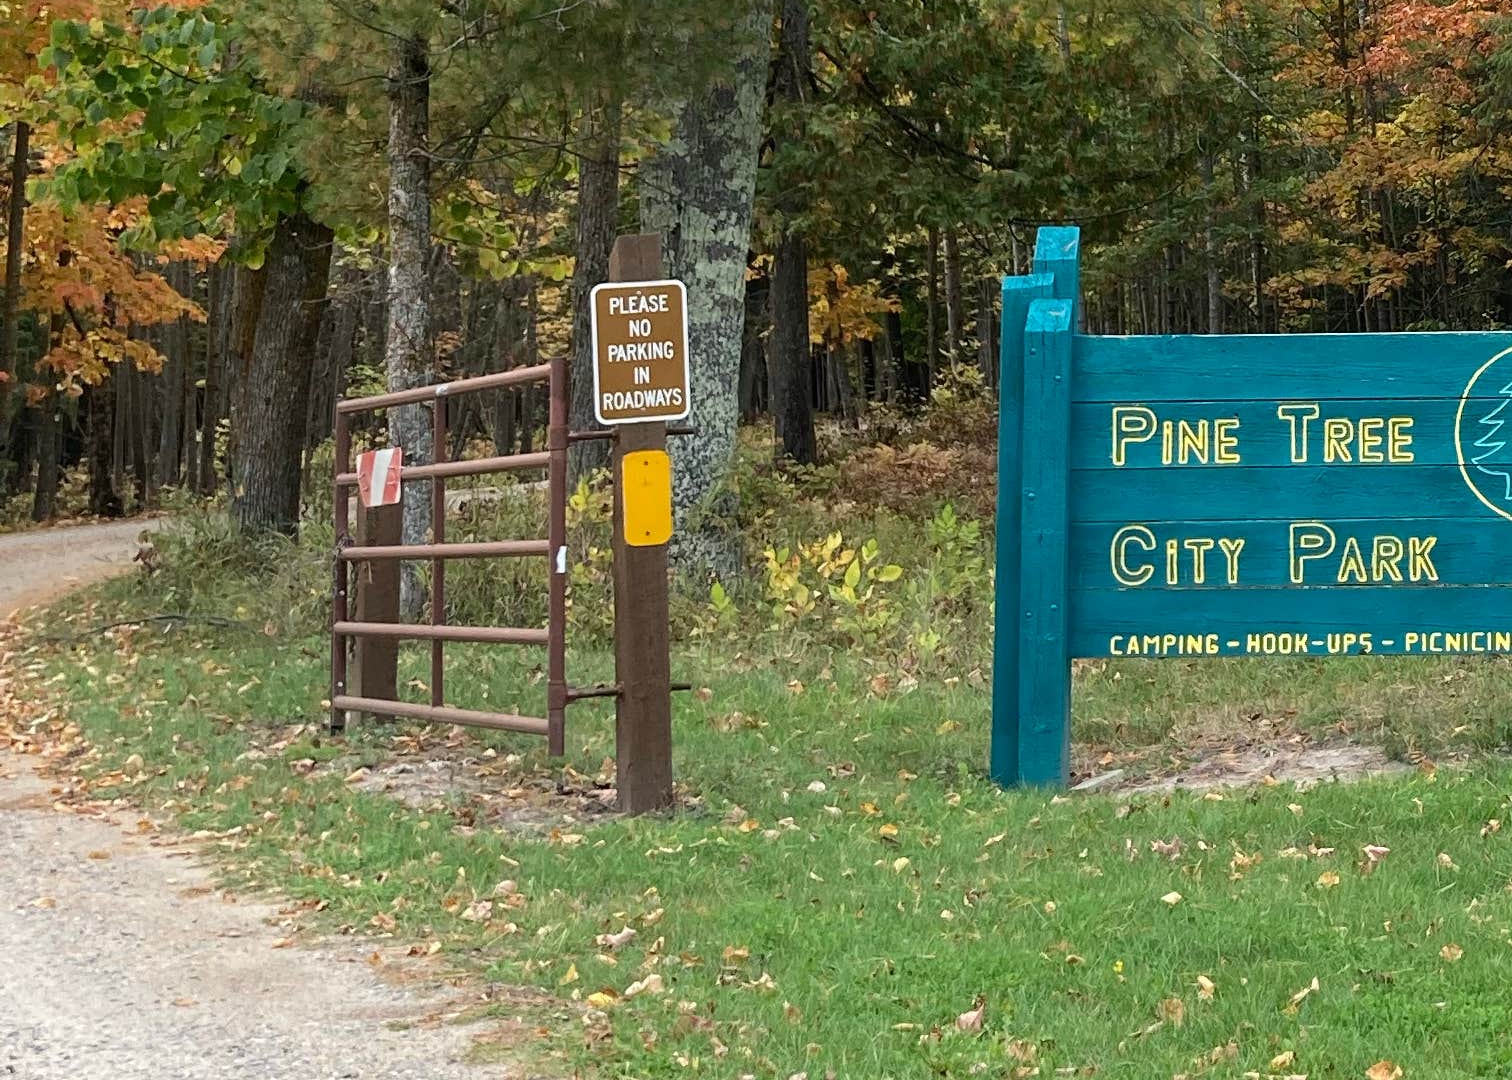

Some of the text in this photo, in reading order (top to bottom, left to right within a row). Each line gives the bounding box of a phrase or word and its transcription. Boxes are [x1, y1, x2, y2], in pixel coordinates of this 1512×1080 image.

[609, 294, 669, 315] PLEASE
[629, 319, 651, 337] NO
[608, 341, 674, 362] PARKING
[634, 366, 650, 385] IN
[603, 388, 682, 410] ROADWAYS
[1278, 404, 1415, 463] TREE
[1289, 521, 1439, 583] PARK
[1110, 634, 1219, 655] CAMPING
